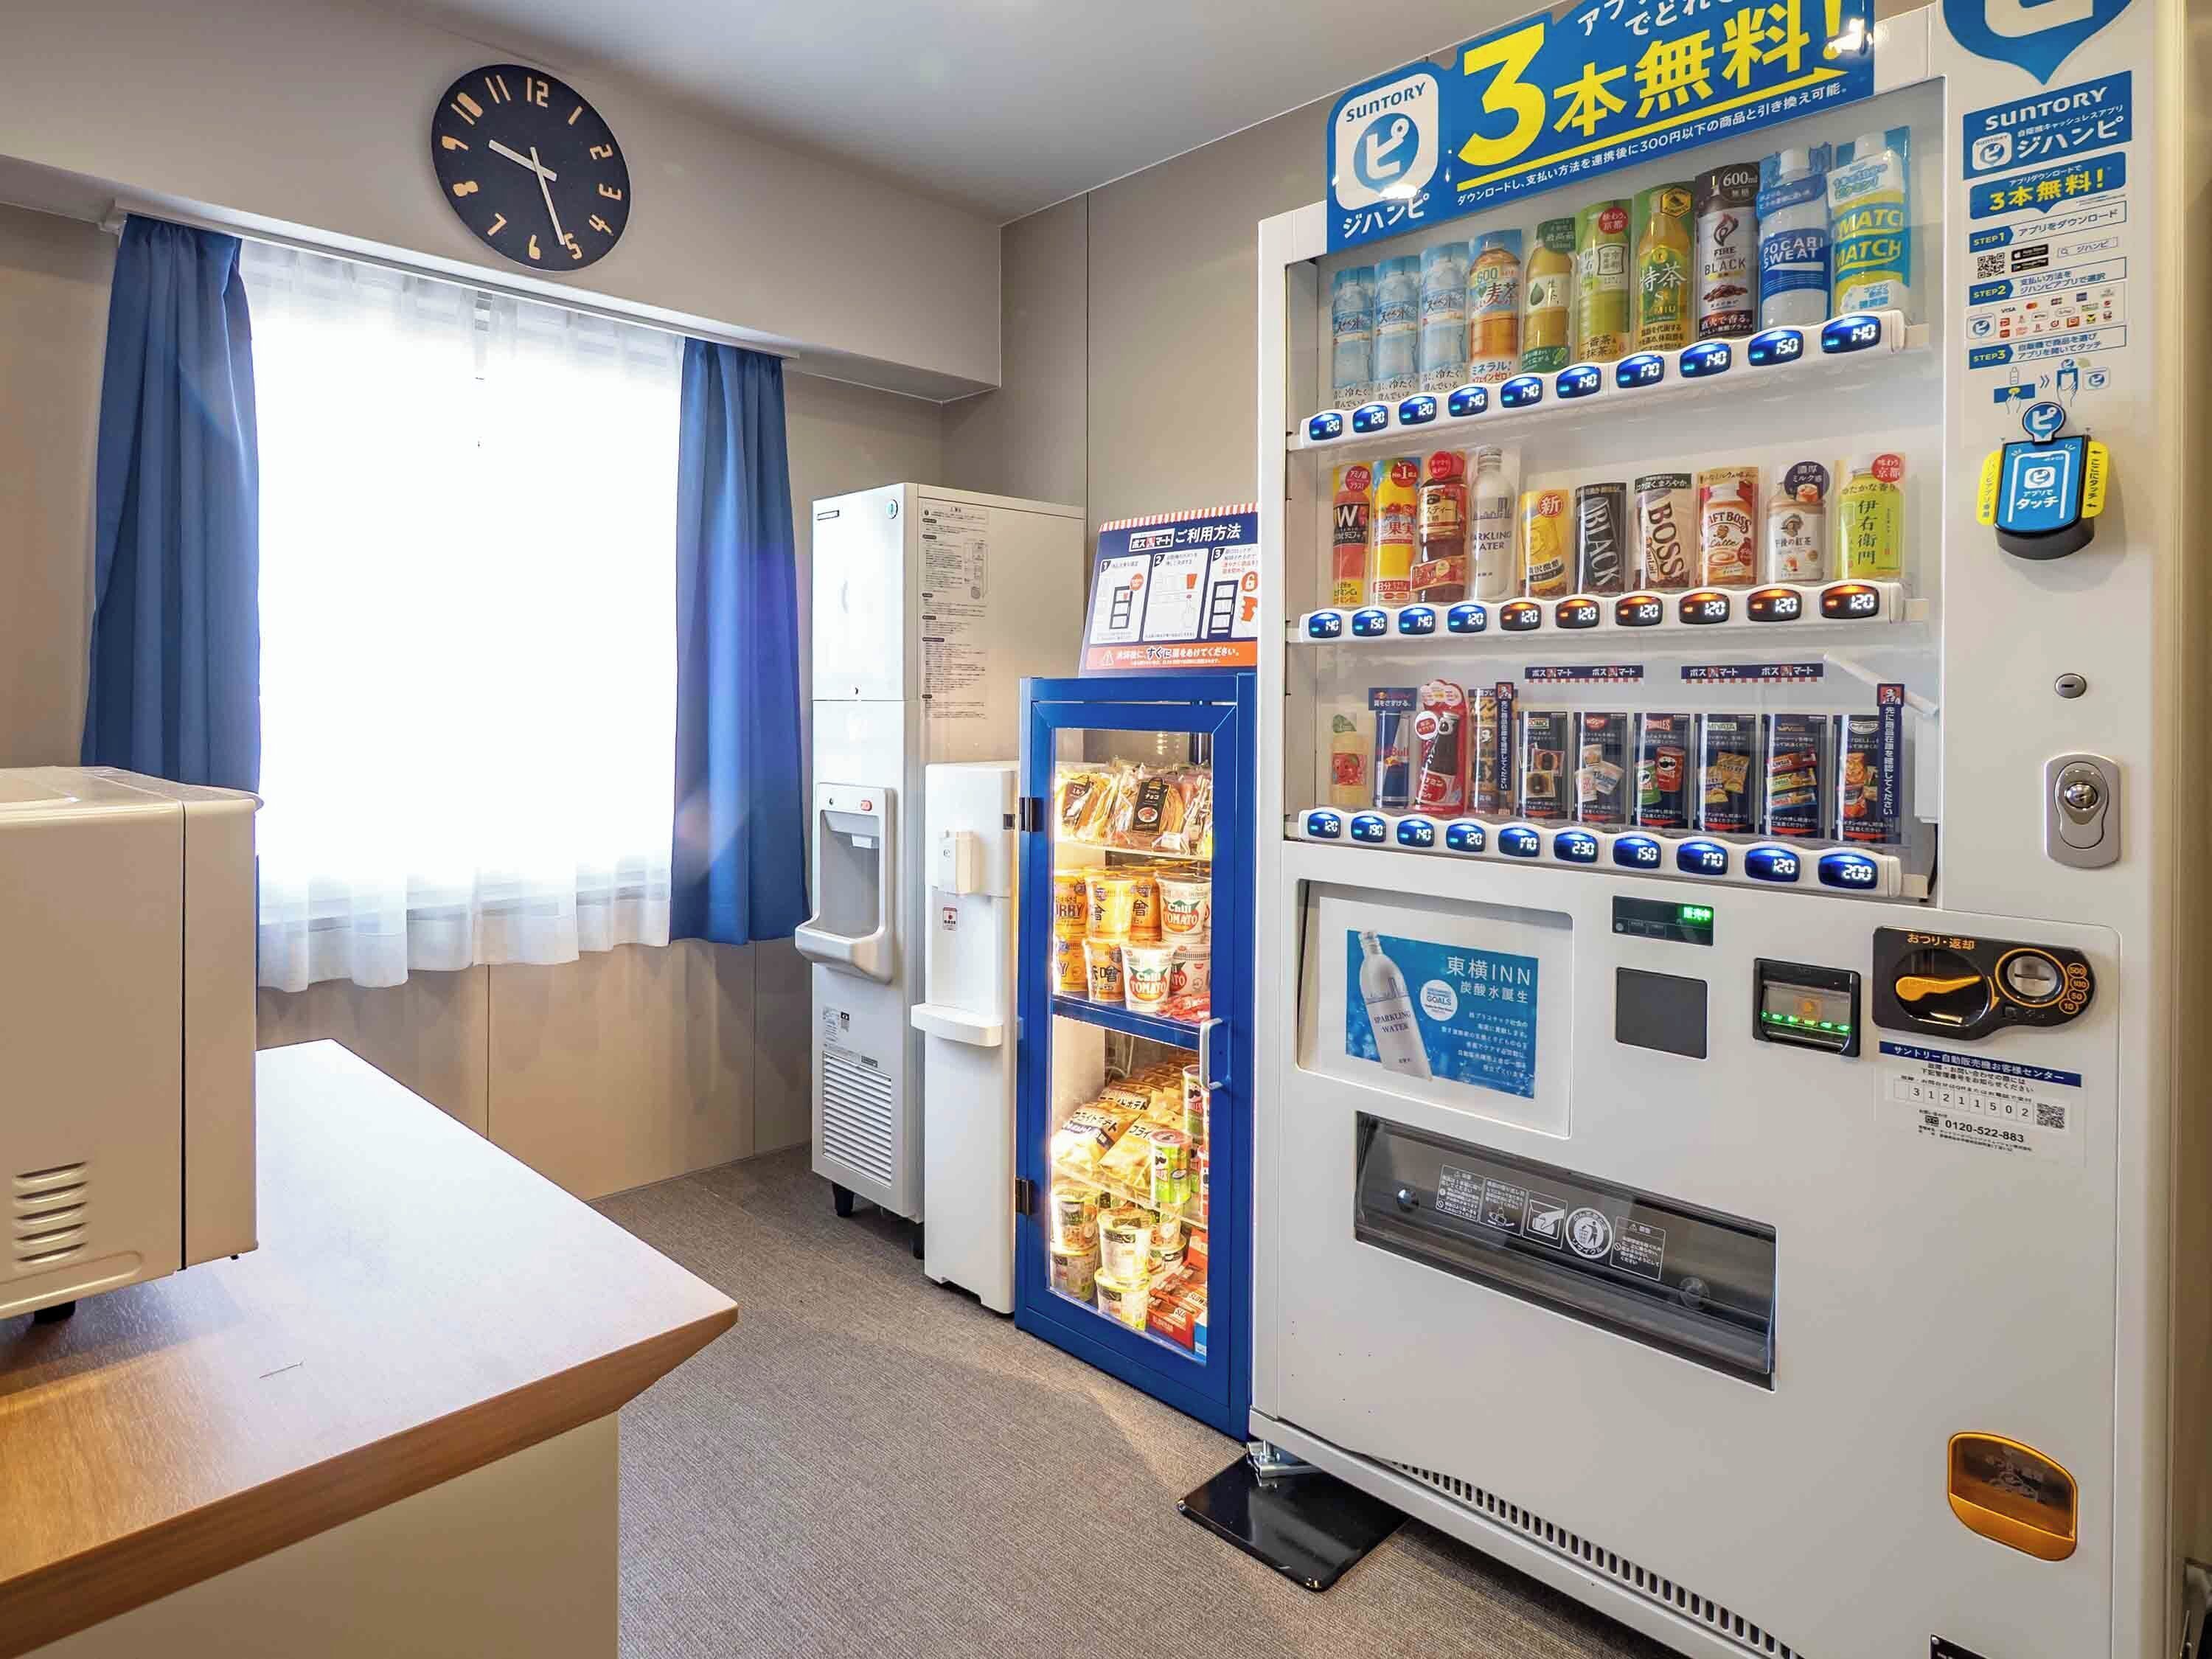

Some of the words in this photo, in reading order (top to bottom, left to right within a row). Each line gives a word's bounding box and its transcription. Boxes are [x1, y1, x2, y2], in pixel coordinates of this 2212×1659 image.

[485, 74, 511, 104] 11
[526, 76, 549, 108] 12
[451, 92, 484, 125] 10
[1346, 82, 1427, 122] SUNTORY
[1985, 86, 2107, 131] SUNTORY
[568, 106, 582, 125] 1
[442, 136, 469, 150] 9
[1457, 83, 1847, 206] ダウンロードし、支払い方法を連携後に300円以下の商品と引き換え可能。
[2017, 116, 2124, 159] ジハンピ
[589, 144, 613, 160] 2
[1366, 117, 1410, 180] ピ
[453, 181, 479, 197] 8
[599, 184, 622, 201] 3
[1989, 168, 2104, 211] 3本無料!
[1343, 192, 1430, 239] ジハンピ
[2019, 209, 2118, 237] アプリをダウンロード
[487, 212, 507, 237] 7
[589, 214, 613, 237] 4
[529, 234, 541, 260] 6
[564, 232, 582, 260] 5
[1713, 246, 1736, 257] FIRE
[1763, 236, 1823, 257] POCARI
[1704, 257, 1747, 276] BLACK
[1763, 248, 1818, 269] SWEAT
[1851, 324, 1876, 341] 140
[1775, 338, 1798, 355] 150
[1706, 350, 1727, 366] 140
[1579, 374, 1598, 389] 140
[1523, 384, 1540, 398] 140
[1418, 403, 1433, 416] 120
[1469, 394, 1484, 408] 140
[1371, 411, 1385, 424] 120
[2032, 407, 2058, 430] ピ
[1326, 421, 1340, 432] 120
[1541, 494, 1562, 515] 新
[2017, 495, 2059, 510] タッチ
[1338, 505, 1358, 528] W
[1727, 511, 1752, 534] BOSS
[1175, 522, 1242, 544] ご利用方法
[1648, 501, 1685, 577] BOSS
[1857, 499, 1879, 566] 伊右衛門
[1585, 501, 1621, 586] BLACK
[1639, 604, 1659, 618] 120
[1704, 601, 1725, 616] 120
[1775, 597, 1798, 613] 120
[1849, 594, 1874, 611] 120
[1416, 616, 1433, 628] 140
[1467, 612, 1484, 626] 120
[1520, 609, 1537, 623] 120
[1577, 607, 1596, 621] 120
[1325, 619, 1339, 632] 140
[1370, 617, 1384, 630] 150
[1324, 819, 1338, 832] 120
[1368, 823, 1383, 836] 190
[1416, 827, 1431, 841] 140
[1466, 832, 1482, 845] 120
[1571, 840, 1594, 855] 230
[1638, 846, 1657, 861] 150
[1773, 858, 1795, 874] 120
[1842, 864, 1872, 880] 200
[1164, 913, 1197, 925] TOMATO
[1906, 933, 1975, 950] おつり・返却
[1447, 956, 1531, 986] 東横INN
[1131, 980, 1167, 993] TOMATO
[1460, 980, 1528, 1004] 炭酸水誕生
[1374, 1011, 1412, 1023] SPARKLING
[1382, 1023, 1409, 1033] WATER
[1893, 1045, 2065, 1081] サントリー自動販売機お客様センター
[1945, 1119, 2025, 1143] 0120-522-883
